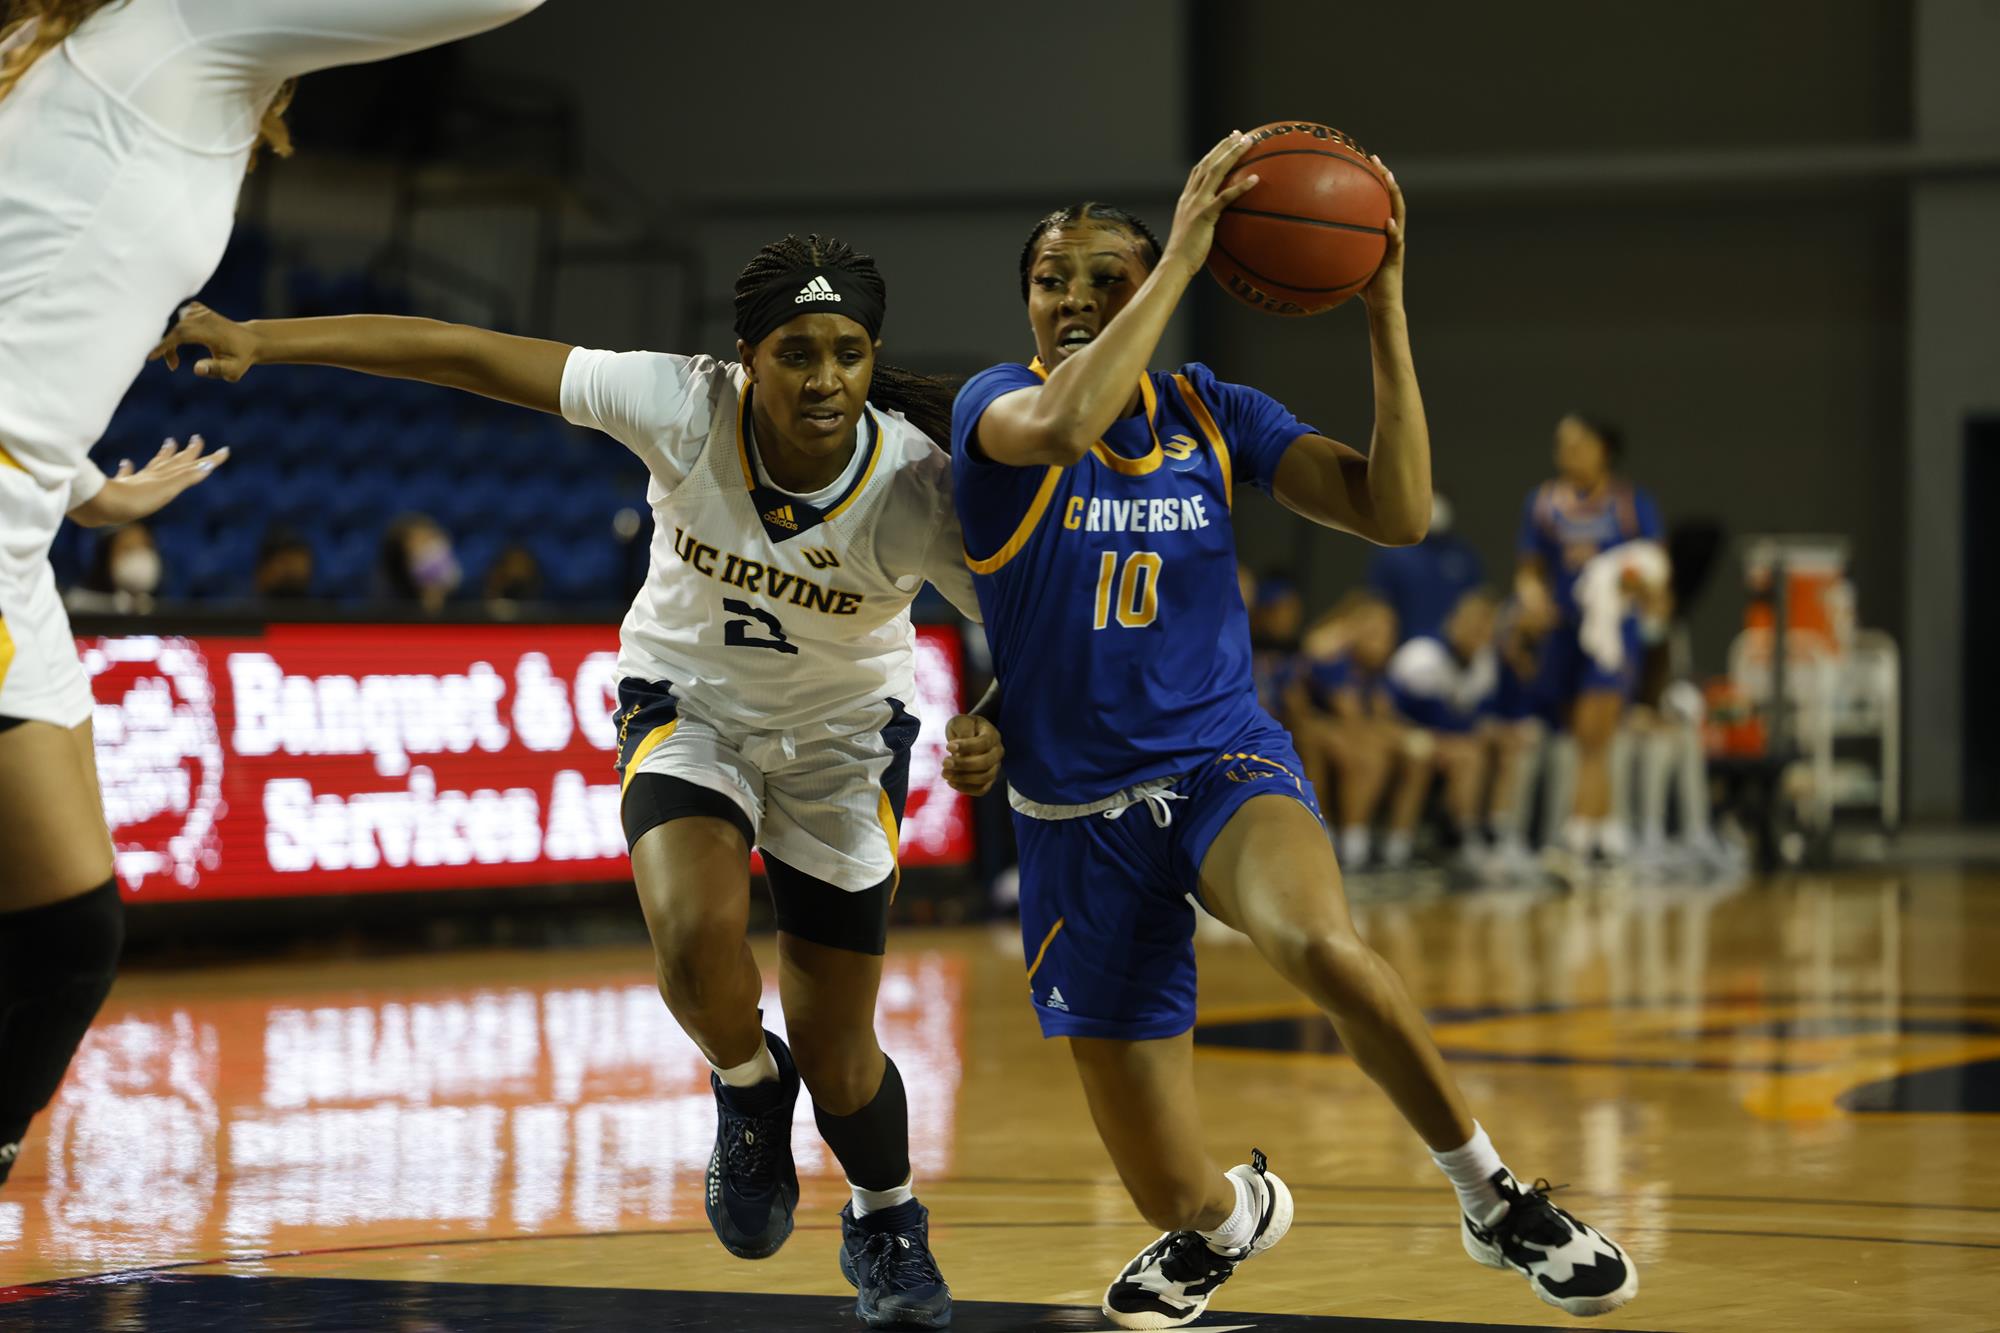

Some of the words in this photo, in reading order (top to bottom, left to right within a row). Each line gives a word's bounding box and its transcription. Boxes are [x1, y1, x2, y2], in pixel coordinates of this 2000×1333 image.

[794, 291, 842, 304] adidas
[763, 510, 799, 531] adidas
[674, 527, 720, 578] UC
[721, 554, 864, 615] IRVINE
[1093, 551, 1163, 630] 10
[227, 652, 510, 778] Banquet
[263, 765, 542, 873] Services
